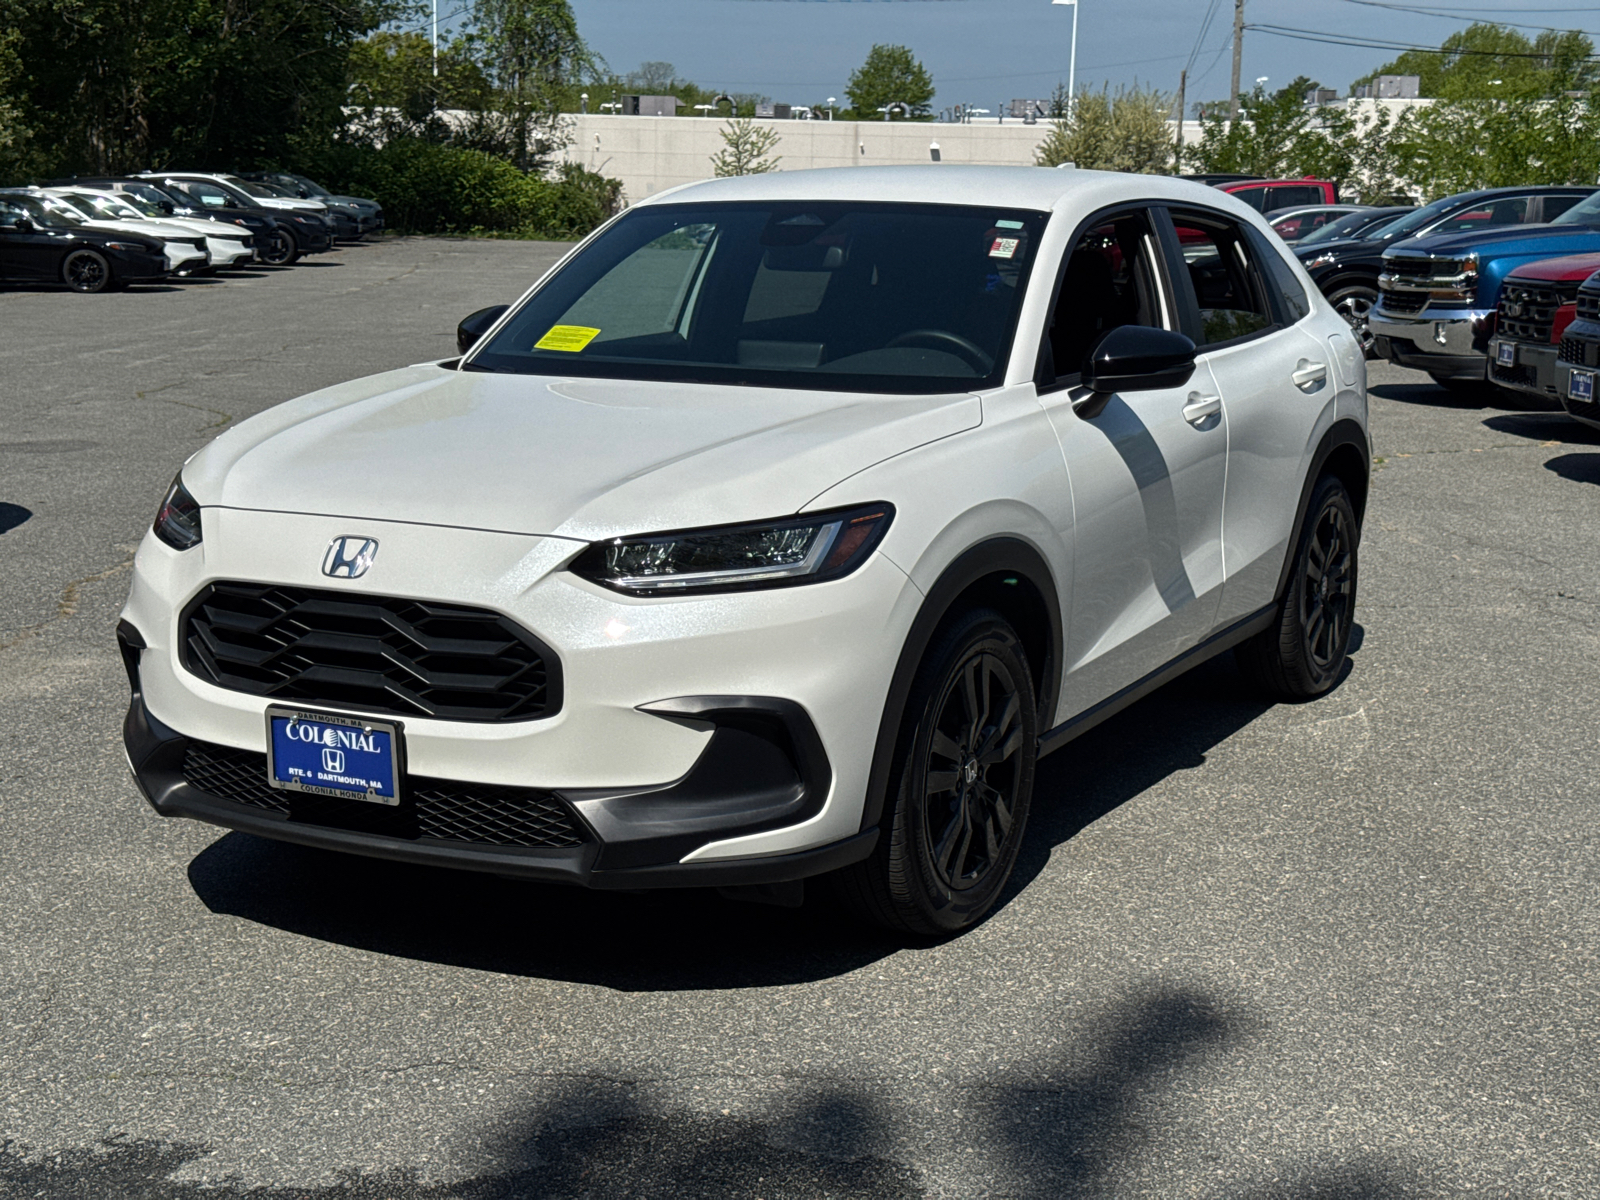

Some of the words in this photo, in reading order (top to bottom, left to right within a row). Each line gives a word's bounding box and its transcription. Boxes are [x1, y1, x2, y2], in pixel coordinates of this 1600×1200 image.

[350, 719, 363, 727] MA
[285, 722, 381, 753] COLONIAL
[288, 767, 306, 777] RTE.
[306, 770, 313, 778] 6
[317, 772, 369, 788] DARTMOUTH,
[369, 780, 383, 789] MA
[300, 784, 338, 796] COLONIAL
[339, 791, 368, 801] HONDA
